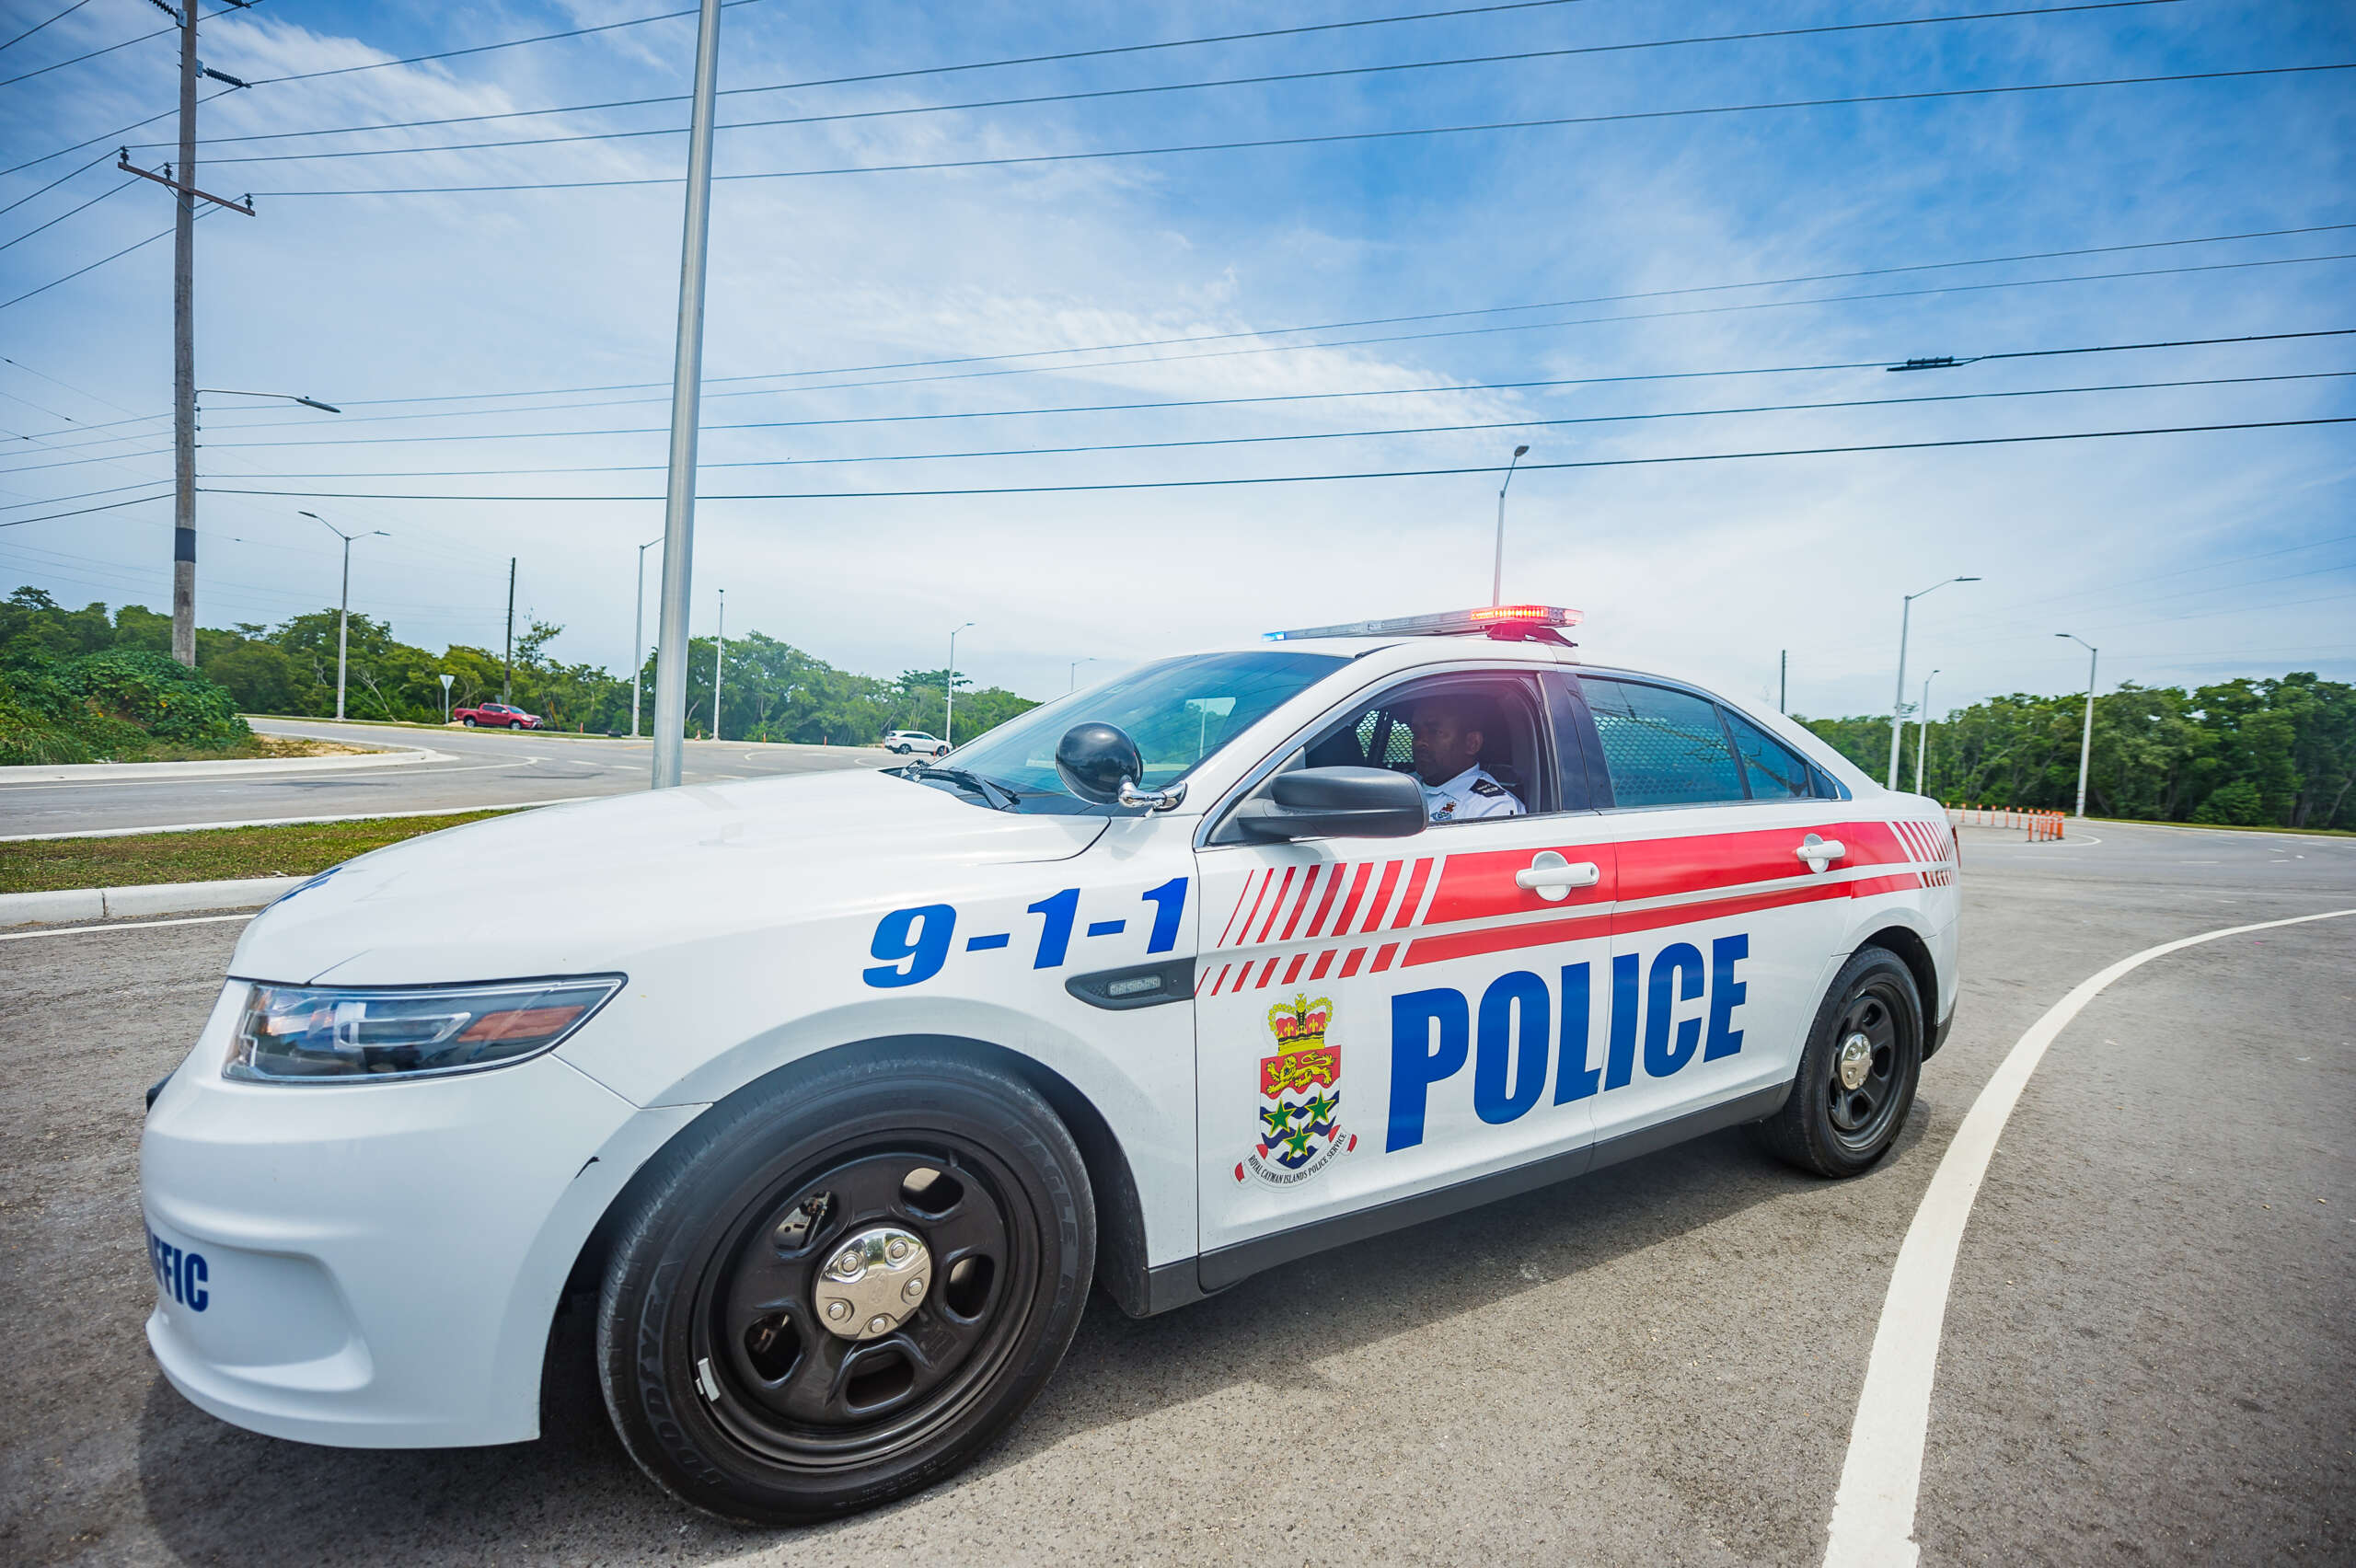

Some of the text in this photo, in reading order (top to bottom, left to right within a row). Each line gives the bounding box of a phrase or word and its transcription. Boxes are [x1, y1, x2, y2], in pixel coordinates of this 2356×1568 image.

[863, 877, 1189, 988] 9-1-1
[1386, 933, 1749, 1153] POLICE
[1248, 1133, 1347, 1184] ROYAL CAYMAN ISLANDS POLICE SERVICE
